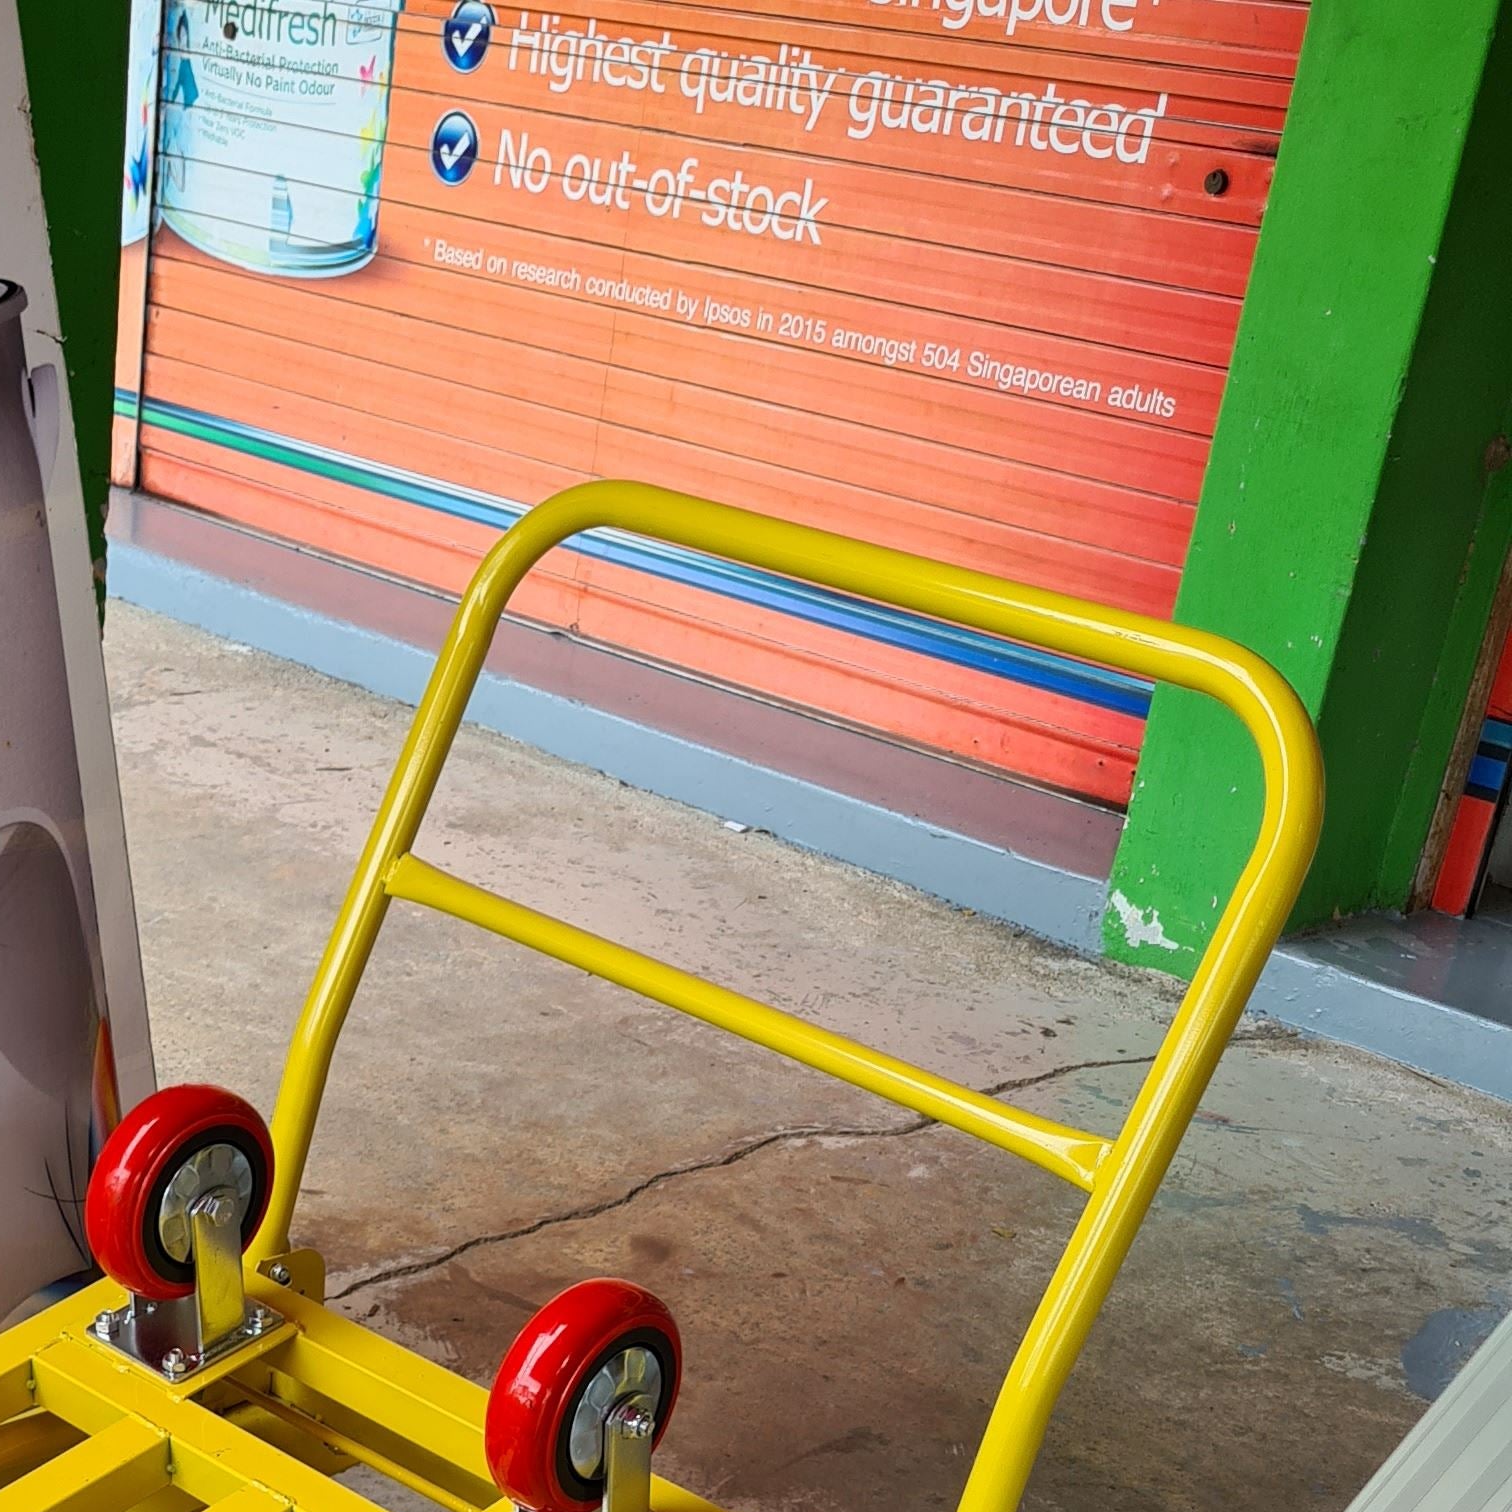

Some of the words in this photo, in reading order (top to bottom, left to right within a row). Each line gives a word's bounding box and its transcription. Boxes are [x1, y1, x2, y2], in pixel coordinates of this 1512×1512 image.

[202, 37, 275, 67] Anti-Bacterial
[279, 55, 338, 76] Protection
[202, 57, 244, 86] Virtually
[245, 71, 262, 88] No
[265, 76, 295, 95] Paint
[299, 79, 336, 97] Odour
[507, 12, 677, 94] Highest
[679, 43, 846, 132] quality
[846, 69, 1169, 165] guaranteed
[493, 128, 552, 195] No
[562, 150, 830, 246] out-of-stock
[486, 254, 507, 275] on
[510, 260, 582, 292] research
[585, 276, 671, 311] conducted
[676, 287, 700, 319] by
[702, 296, 752, 328] Ipsos
[756, 306, 774, 333] in
[777, 312, 828, 344] 2015
[831, 327, 916, 366] amongst
[921, 343, 961, 374] 504
[966, 350, 1102, 402] Singaporean
[1107, 383, 1177, 419] adults
